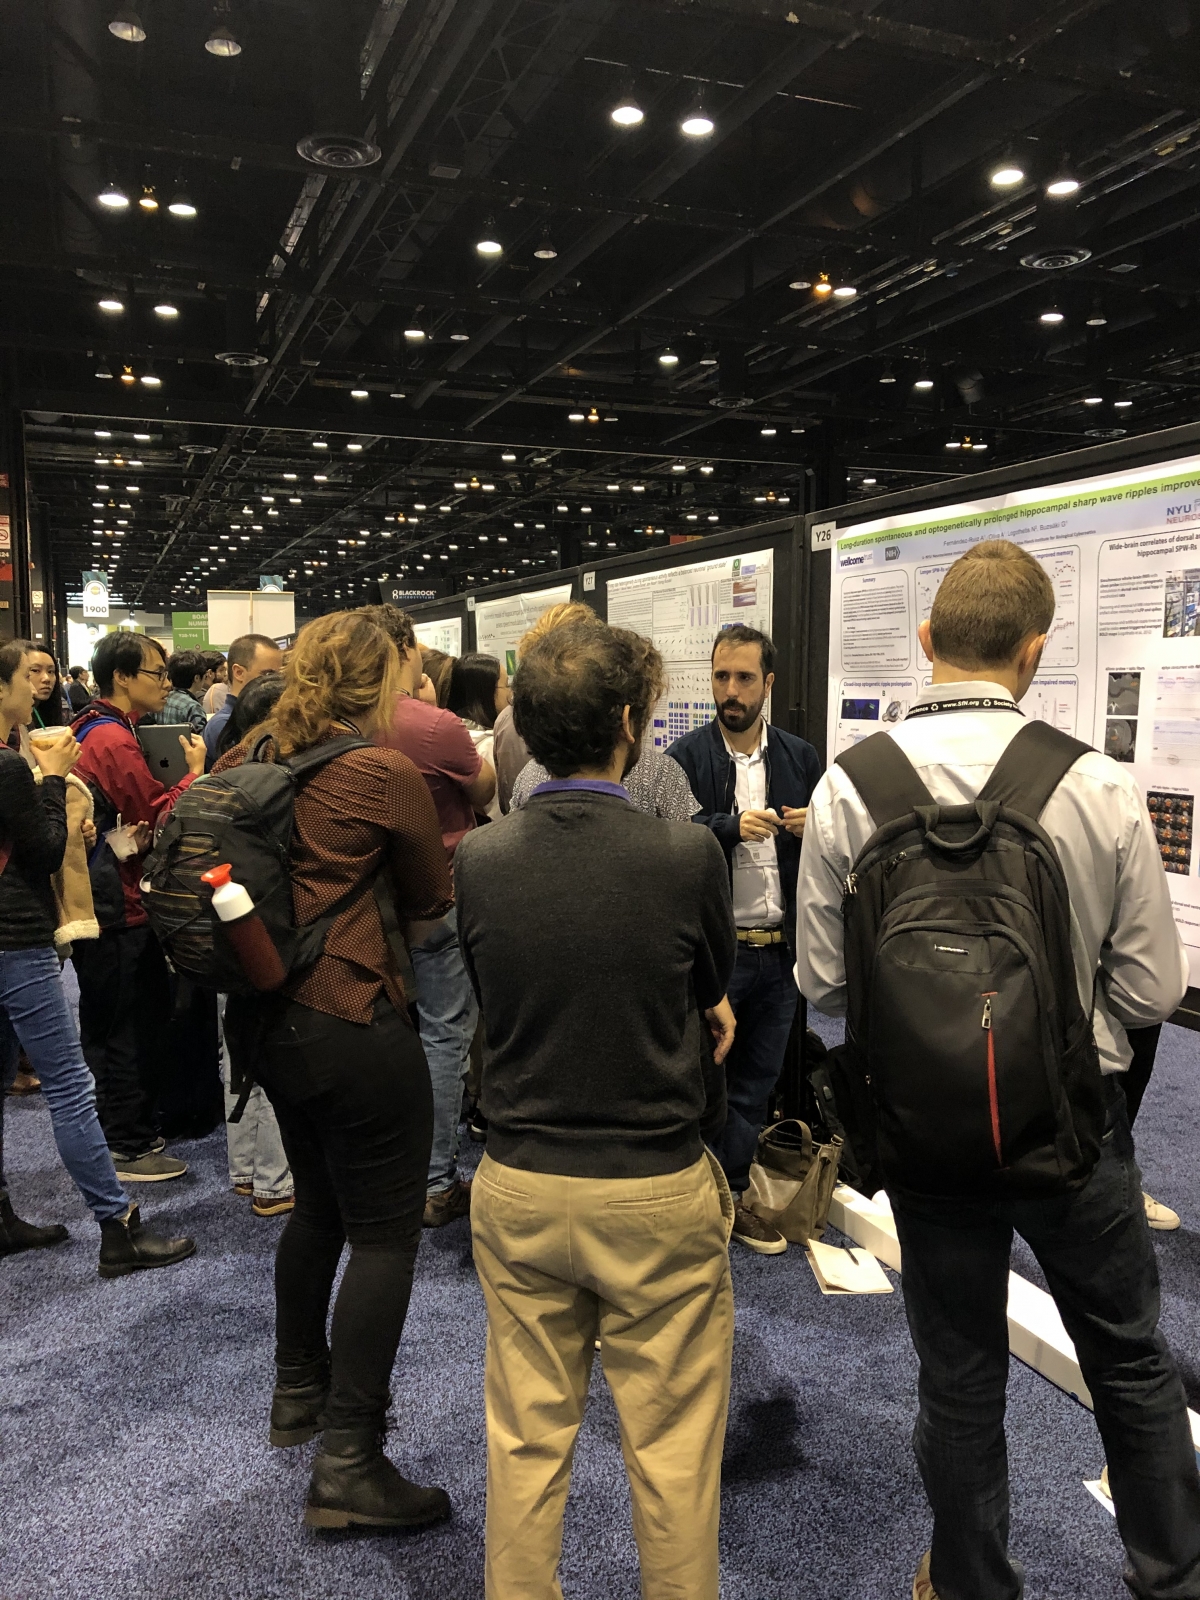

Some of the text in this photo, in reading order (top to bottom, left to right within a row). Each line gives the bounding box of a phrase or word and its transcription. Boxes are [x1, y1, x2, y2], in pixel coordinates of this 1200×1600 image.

[1166, 503, 1192, 516] NYU
[840, 538, 874, 550] Long-duration
[875, 529, 913, 543] spontaneous
[914, 527, 927, 537] and
[928, 518, 982, 535] optogenetically
[984, 511, 1018, 526] prolonged
[1020, 500, 1071, 518] hippocampal
[1072, 497, 1098, 509] sharp
[1100, 493, 1123, 503] wave
[1125, 486, 1158, 499] ripples
[815, 529, 831, 543] Y26
[1109, 541, 1139, 551] Wide-brain
[1139, 538, 1168, 547] correlates
[1168, 535, 1176, 543] of
[1176, 533, 1194, 542] dorsal
[1137, 543, 1198, 557] hippocampal SPW-Rs
[840, 555, 864, 568] wellcome
[993, 700, 1013, 708] Society
